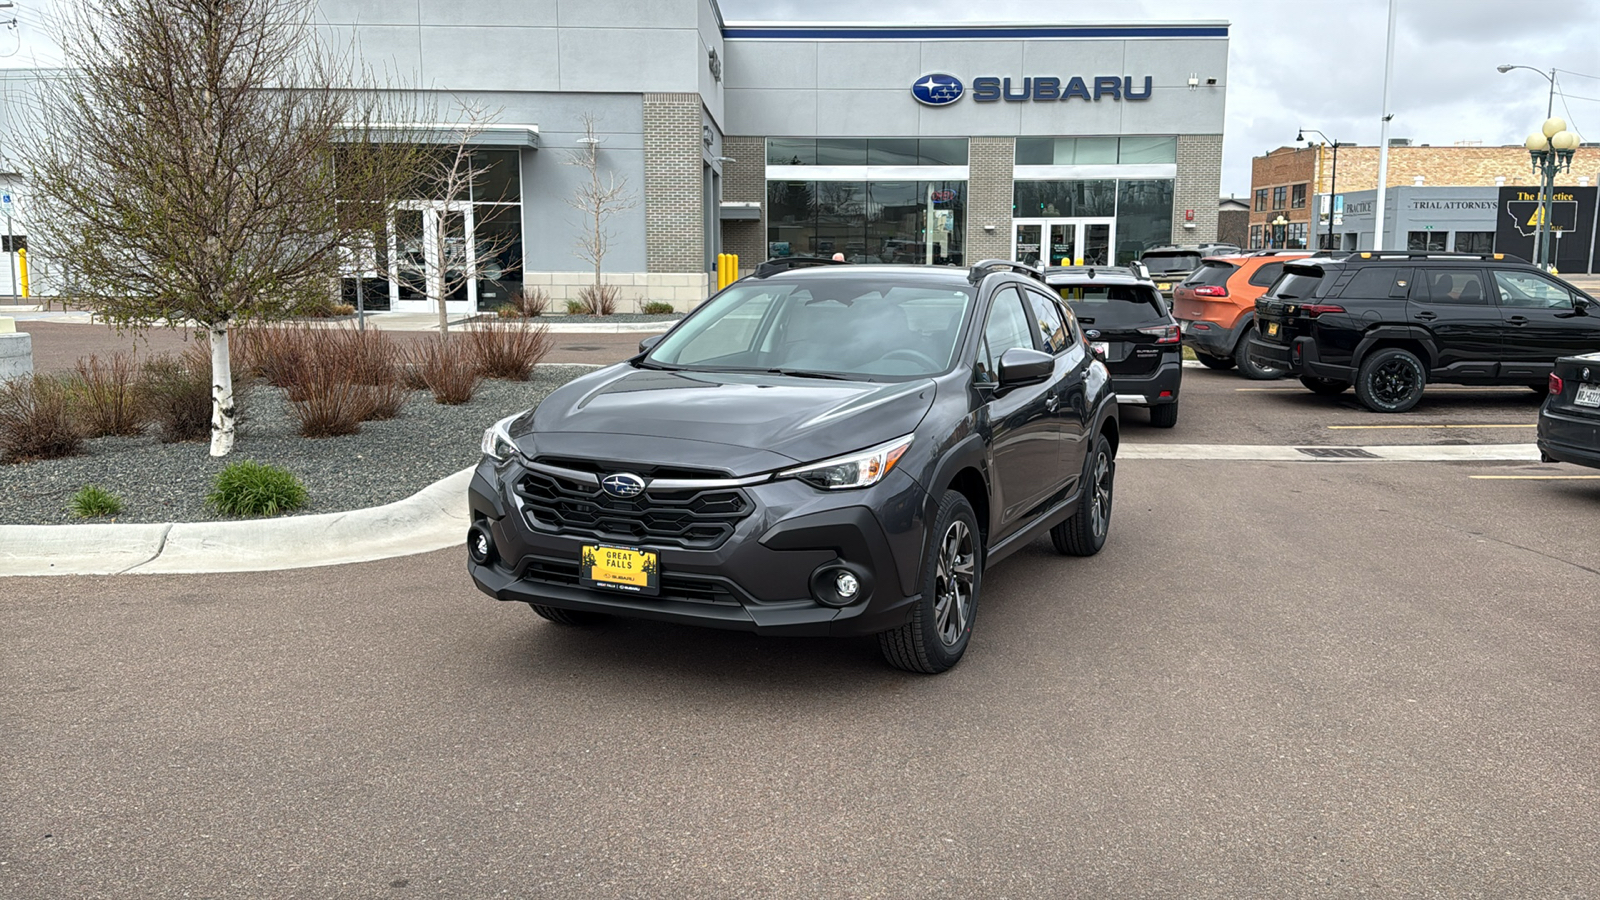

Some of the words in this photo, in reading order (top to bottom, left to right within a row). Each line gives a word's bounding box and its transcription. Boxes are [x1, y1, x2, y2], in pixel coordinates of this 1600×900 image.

[973, 76, 1152, 101] SUBARU
[1517, 191, 1535, 201] The
[1537, 191, 1574, 201] rctice
[1347, 203, 1371, 213] PRACTICE
[1413, 201, 1442, 209] TRIAL
[1443, 201, 1498, 209] ATTORNEYS
[606, 551, 632, 561] GREAT
[606, 559, 632, 569] FALLS
